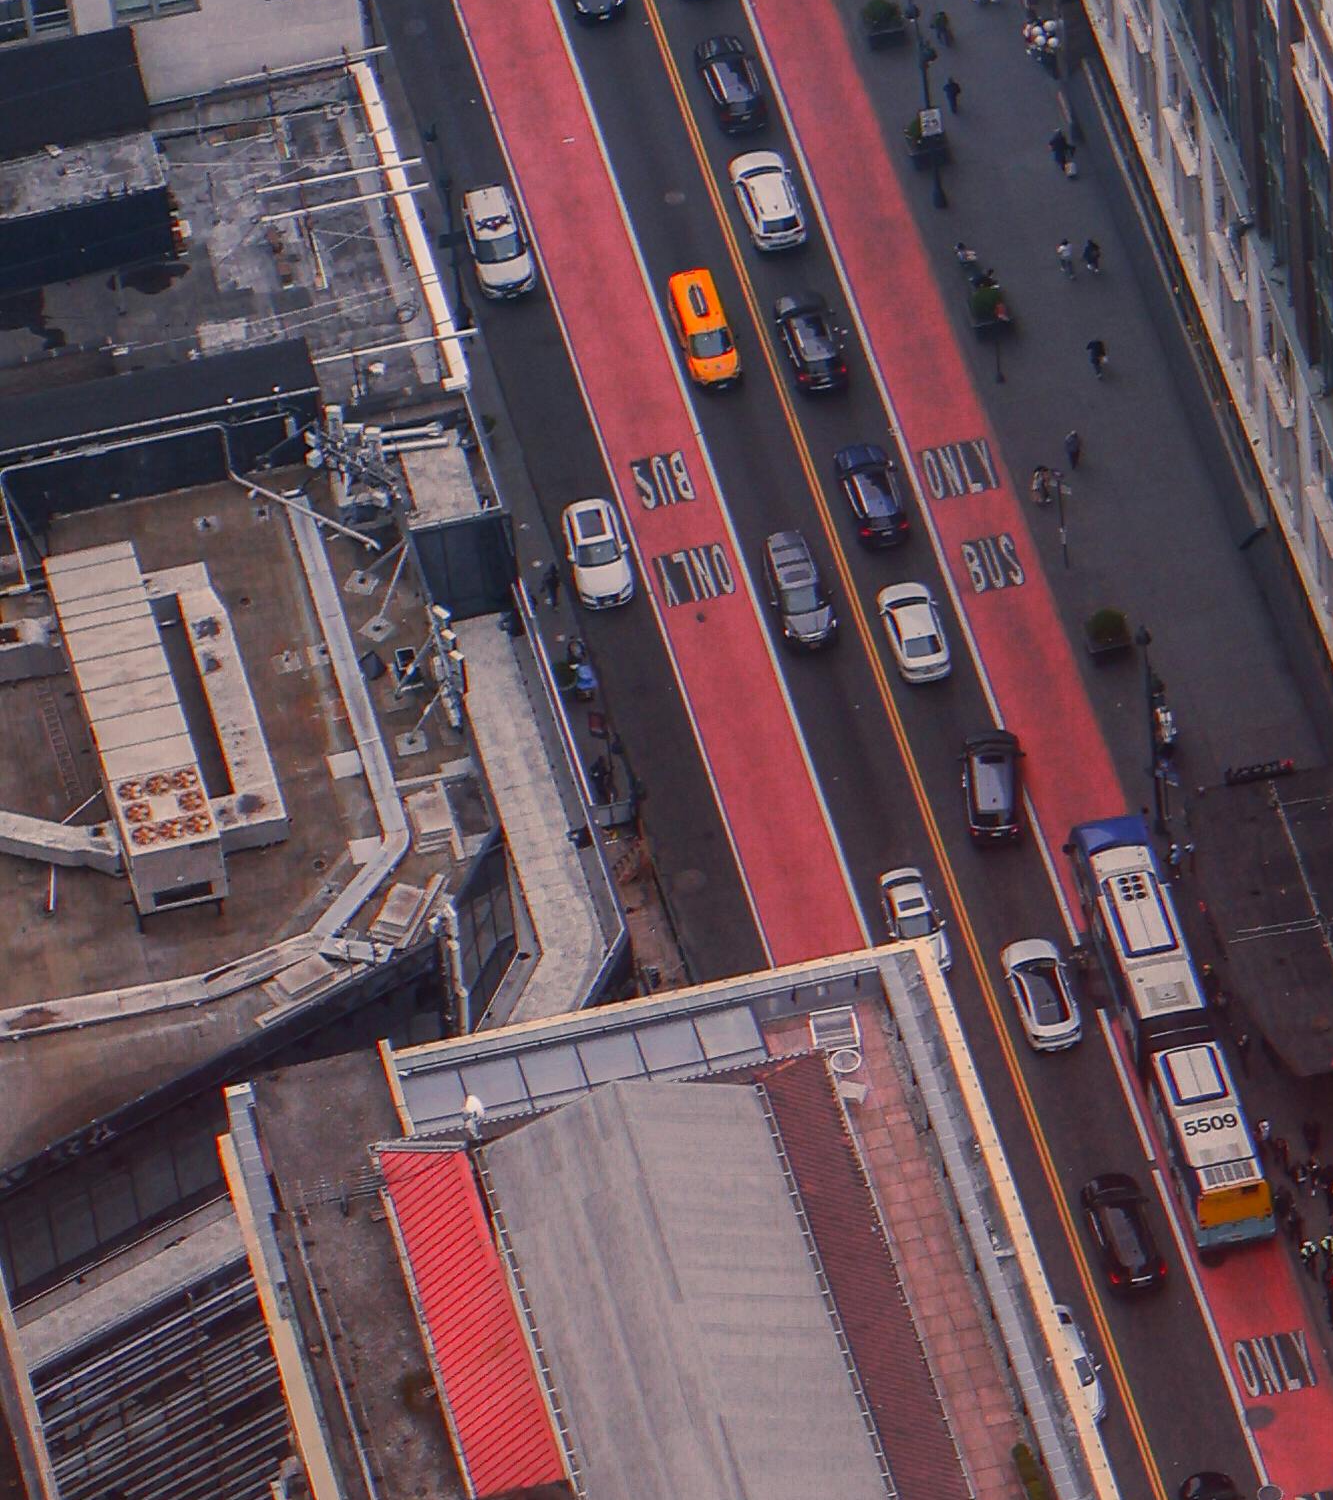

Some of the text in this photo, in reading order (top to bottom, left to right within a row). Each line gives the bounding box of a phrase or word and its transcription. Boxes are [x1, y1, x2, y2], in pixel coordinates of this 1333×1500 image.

[632, 451, 696, 510] BUS
[917, 440, 1000, 500] ONLY
[655, 543, 736, 607] ONLY
[961, 534, 1023, 594] BUS
[1184, 1110, 1238, 1138] 5509
[1232, 1329, 1317, 1397] ONLY
